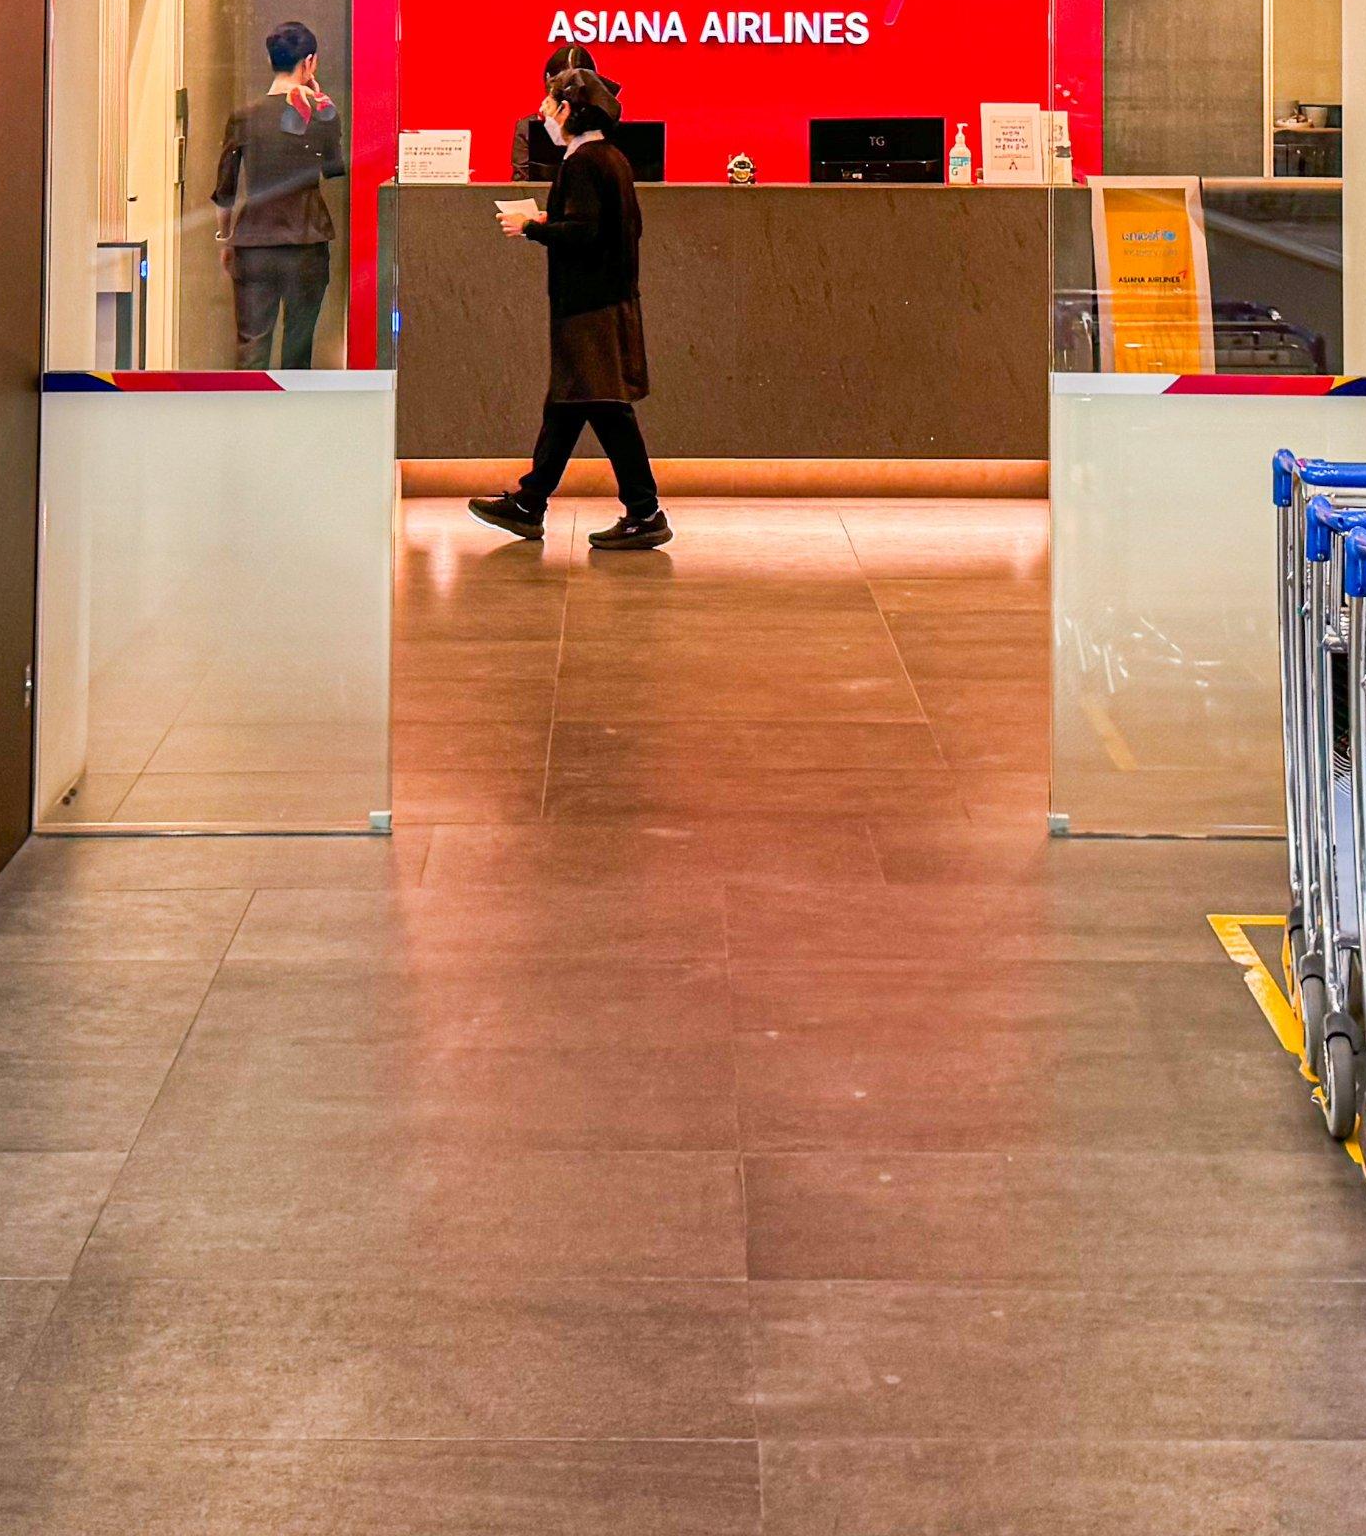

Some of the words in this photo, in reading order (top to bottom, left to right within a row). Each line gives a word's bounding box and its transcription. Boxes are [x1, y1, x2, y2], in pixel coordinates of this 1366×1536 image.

[547, 10, 688, 43] ASIANA
[699, 11, 870, 45] AIRLINES
[869, 135, 886, 146] TG
